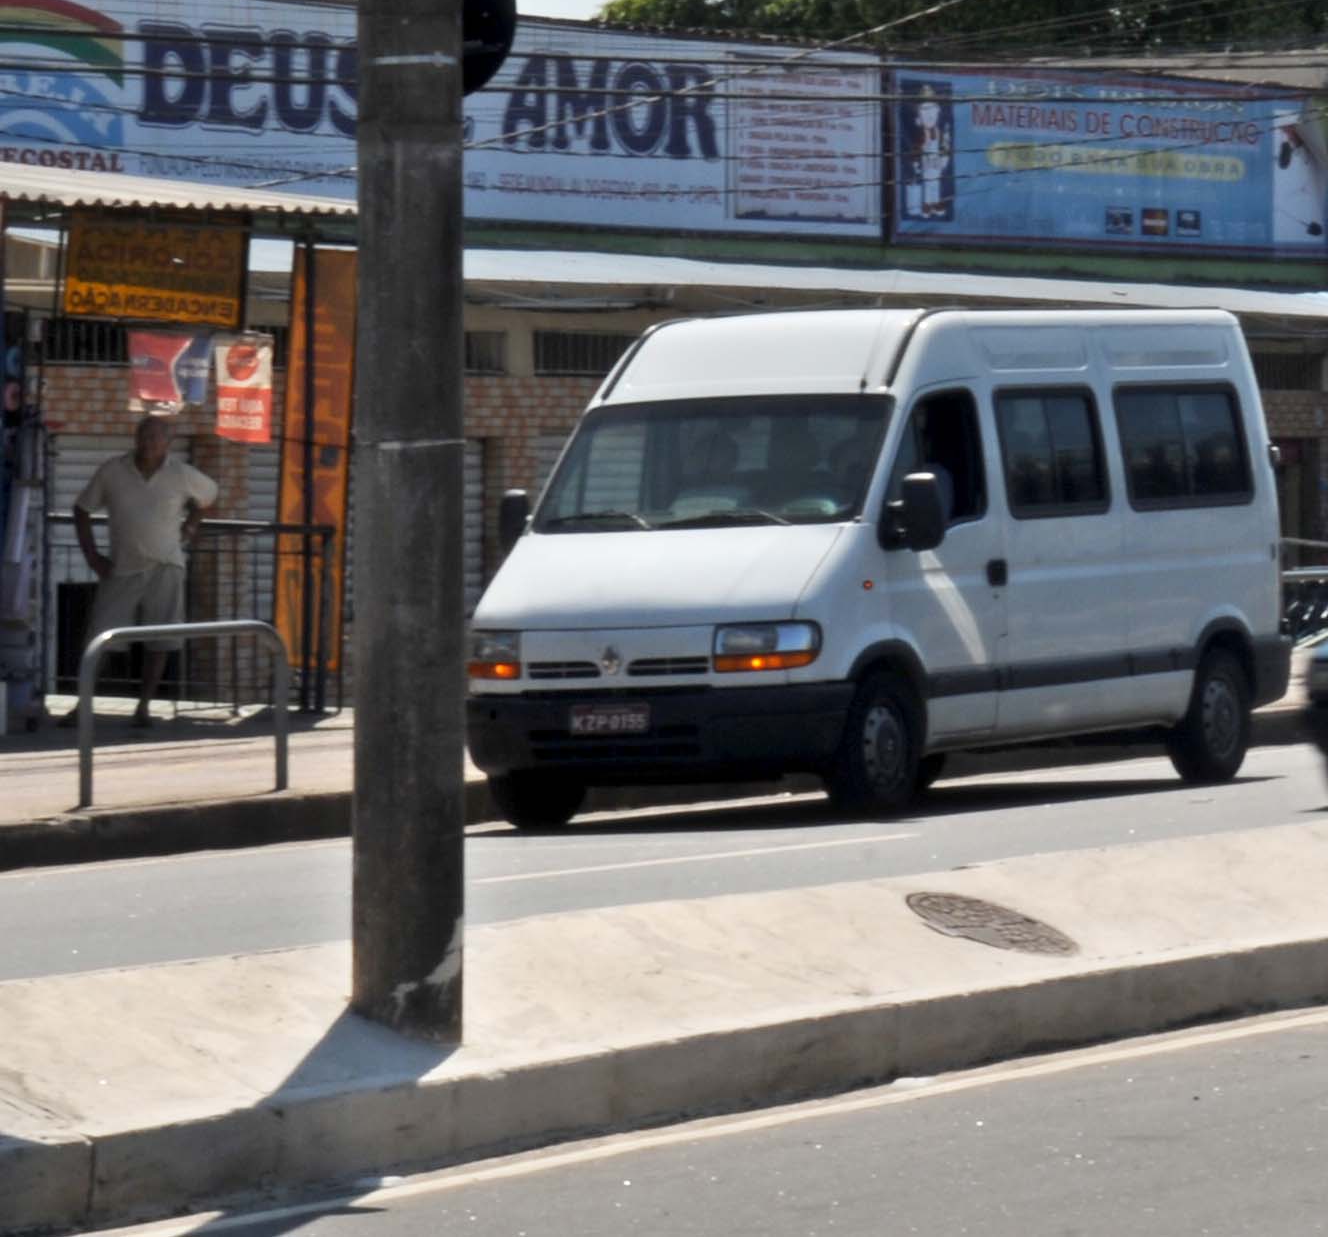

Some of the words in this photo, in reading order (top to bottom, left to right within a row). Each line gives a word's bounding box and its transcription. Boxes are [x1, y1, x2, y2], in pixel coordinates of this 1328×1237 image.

[503, 50, 720, 160] AMOR
[971, 104, 1078, 132] MATERIAIS
[1085, 112, 1112, 135] DE
[0, 147, 124, 172] ECOSTAL
